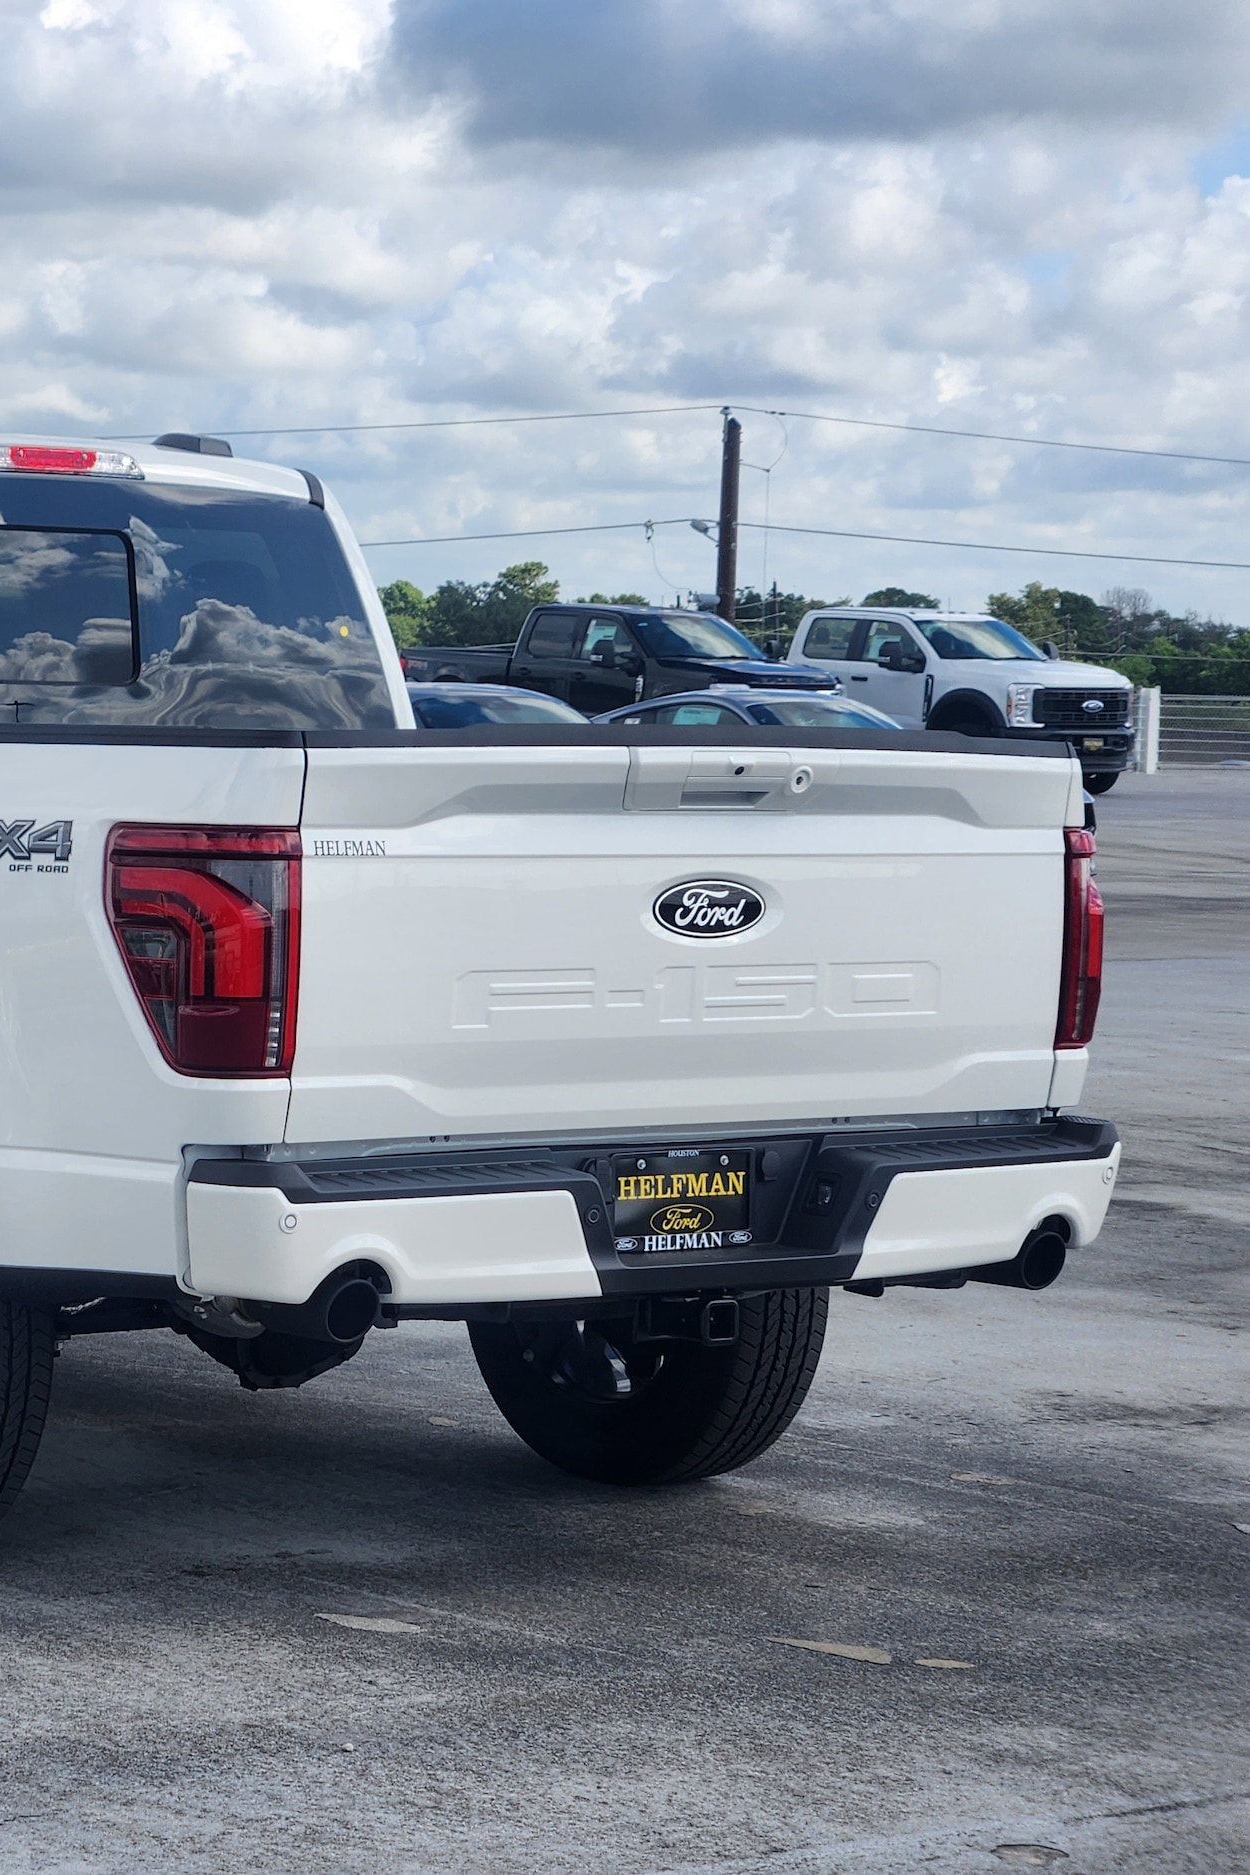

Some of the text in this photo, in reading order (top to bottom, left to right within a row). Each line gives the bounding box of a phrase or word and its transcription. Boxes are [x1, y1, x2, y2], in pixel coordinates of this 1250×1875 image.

[313, 840, 386, 857] HELFMAN
[9, 864, 69, 873] OFF ROAD
[674, 887, 747, 928] Ford
[451, 960, 941, 1029] F-150
[667, 1149, 700, 1158] HOUSTON
[617, 1171, 746, 1200] HELFMAN
[662, 1207, 702, 1231] Ford
[643, 1231, 723, 1252] HELFMAN
